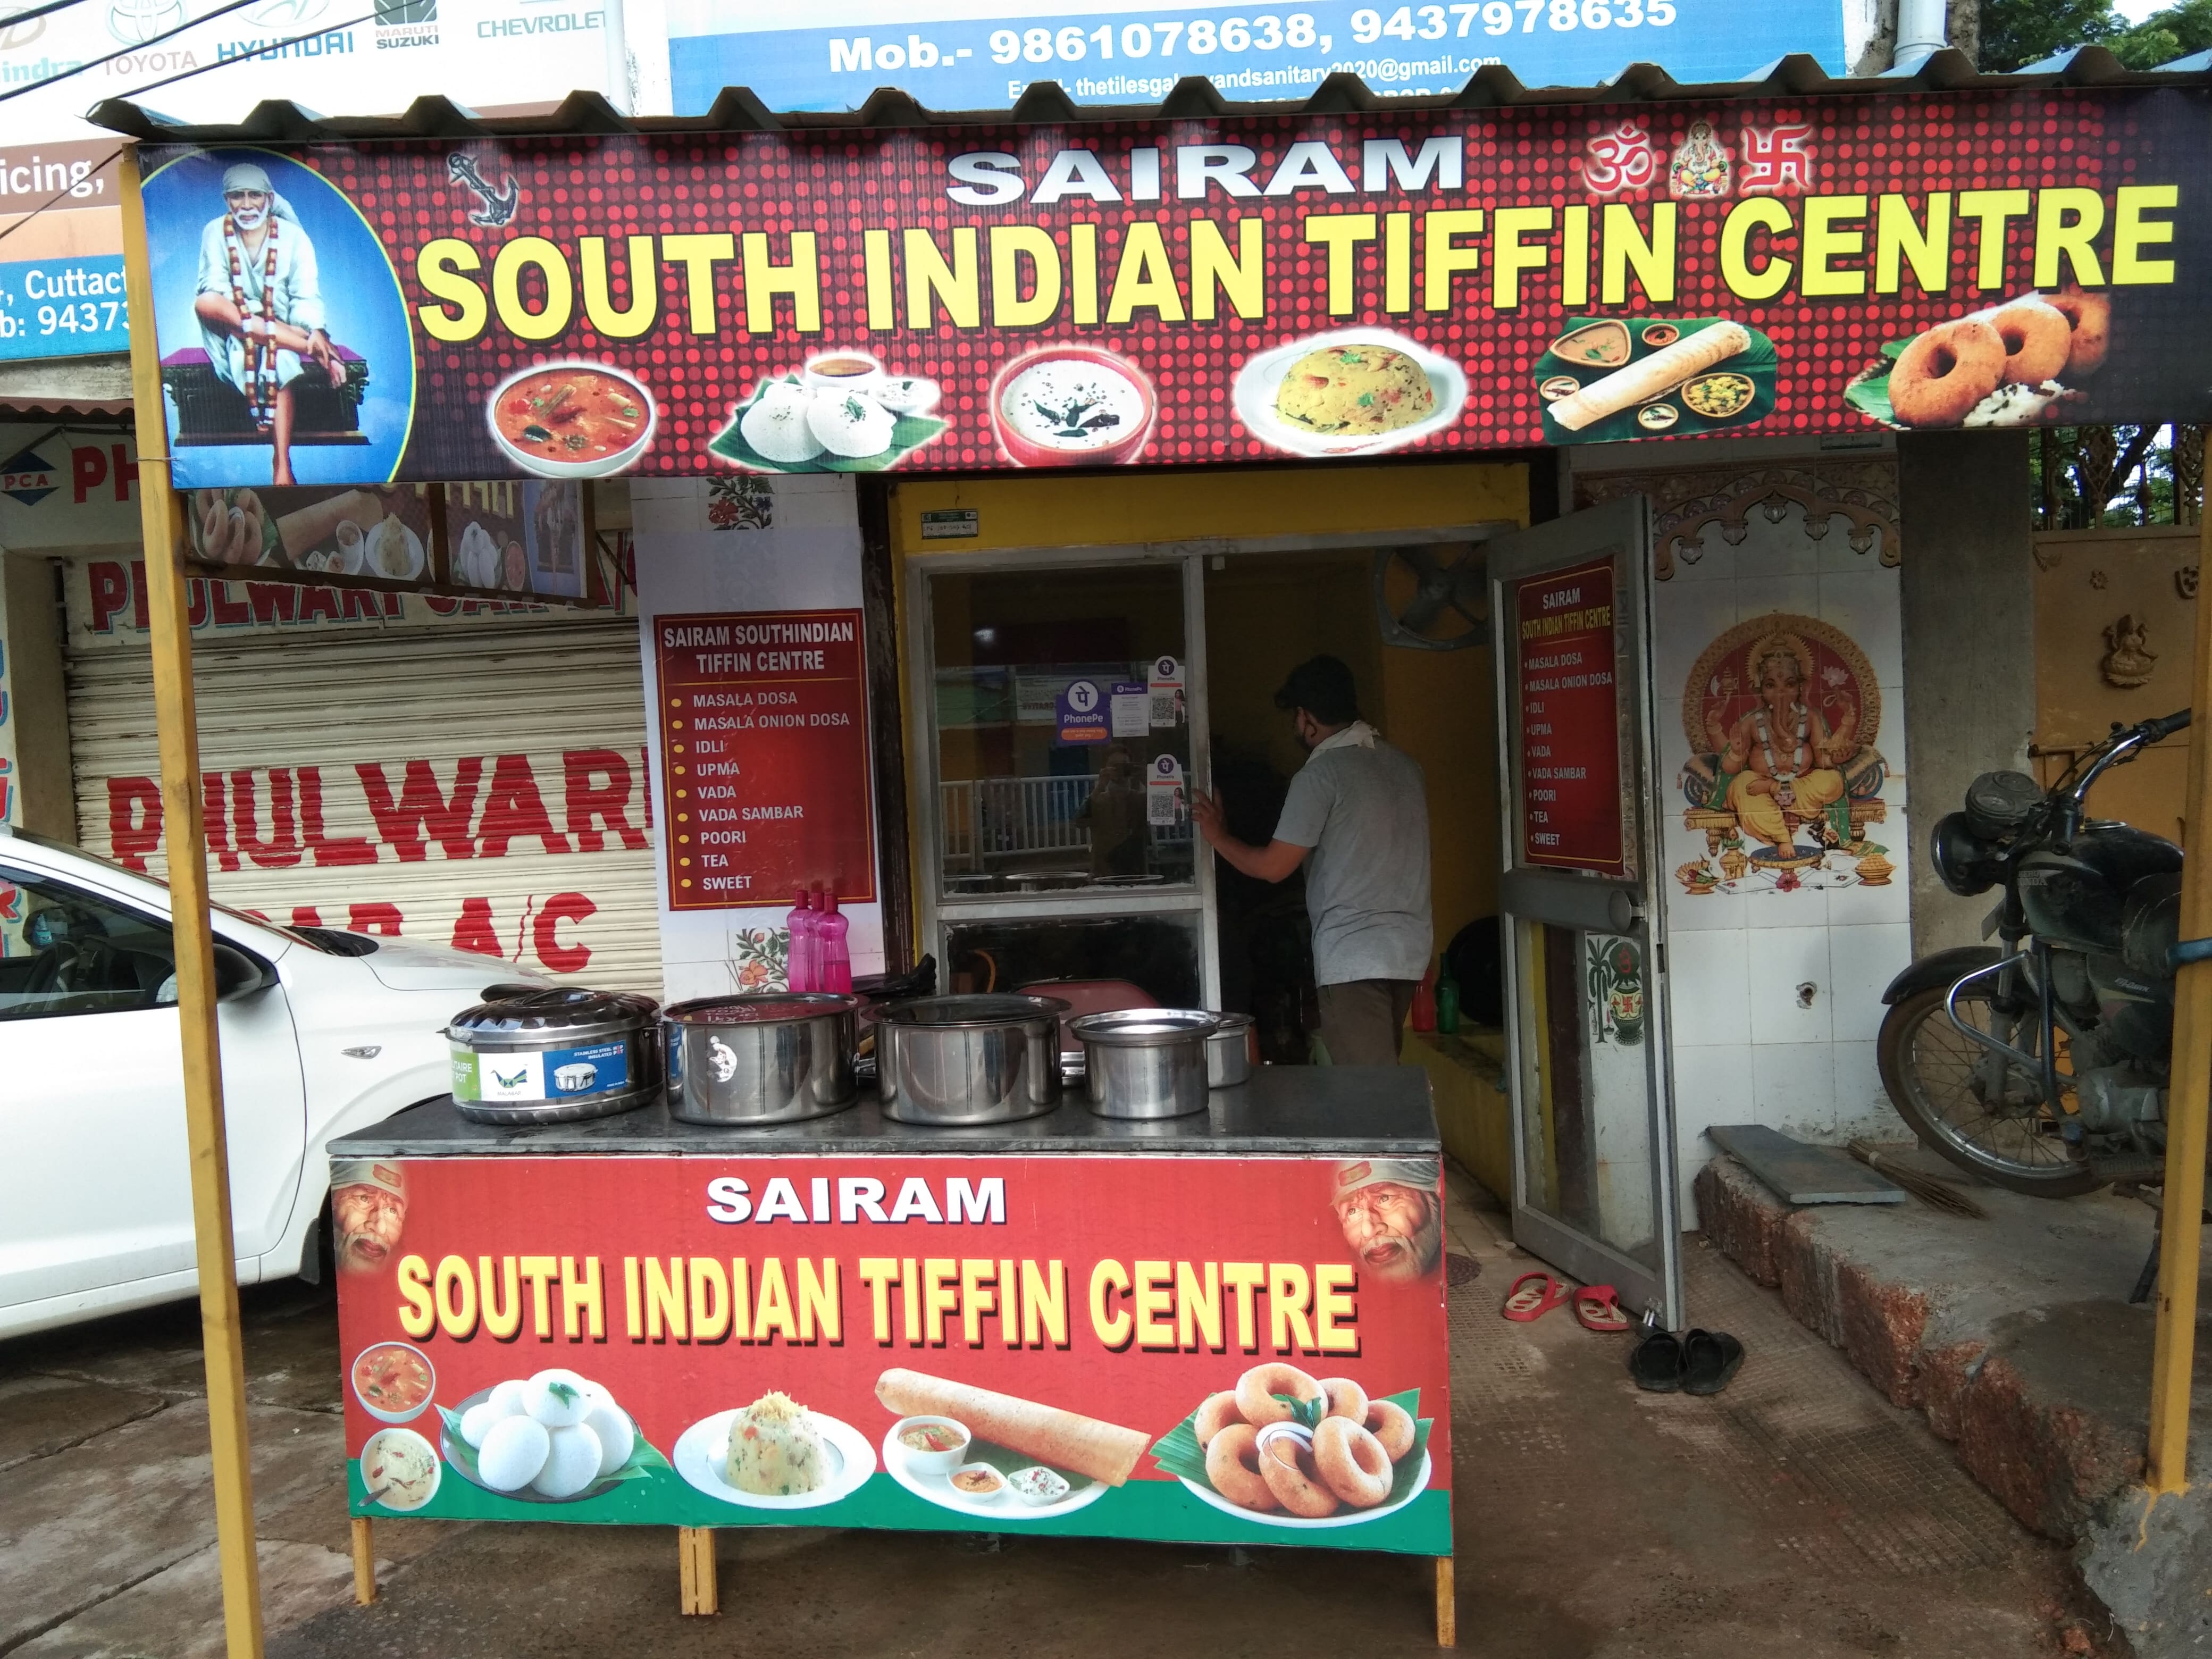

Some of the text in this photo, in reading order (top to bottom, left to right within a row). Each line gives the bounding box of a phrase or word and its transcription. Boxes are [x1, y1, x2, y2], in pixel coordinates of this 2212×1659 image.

[375, 25, 438, 38] MARUTI
[477, 11, 605, 38] CHEVROLET
[376, 35, 439, 49] SUZUKI
[829, 0, 1677, 73] Mob.- 9861078638, 9437978635
[217, 31, 353, 63] HYUNDAI
[2, 56, 84, 83] indra
[105, 51, 198, 76] TOYOTA
[0, 156, 104, 198] icing,
[946, 136, 1462, 206] SAIRAM
[417, 185, 2179, 342] SOUTH INDIAN TIFFIN CENTRE
[0, 301, 129, 338] b: 9437
[4, 474, 48, 489] PCA
[72, 445, 139, 504] PH
[1543, 587, 1580, 610] SAIRAM
[1522, 606, 1611, 640] SOUTH INDIAN TIFFIN CENTRE
[664, 622, 853, 648] SAIRAM SOUTHINDIAN
[696, 650, 825, 674] TIFFIN CENTRE
[1529, 652, 1582, 671] MASALA DOSA
[1529, 671, 1612, 692] MASALA ONION DOSA
[693, 692, 798, 708] MASALA DOSA
[1530, 702, 1544, 714] IDLI
[694, 713, 850, 731] MASALA ONION DOSA
[1063, 714, 1103, 724] PhonePe
[1531, 723, 1552, 735] UPMA
[696, 741, 724, 753] IDLI
[1531, 745, 1551, 757] VADA
[697, 763, 740, 776] UPMA
[1532, 767, 1586, 779] VADA SAMBAR
[698, 786, 736, 799] VADA
[1533, 789, 1556, 801] POORI
[699, 806, 804, 822] VADA SAMBAR
[1534, 811, 1548, 823] TEA
[700, 831, 745, 845] POORI
[1535, 832, 1560, 845] SWEET
[701, 854, 728, 867] TEA
[703, 876, 752, 890] SWEET
[707, 1177, 1007, 1225] SAIRAM
[397, 1254, 1362, 1357] SOUTH INDIAN TIFFIN CENTRE
